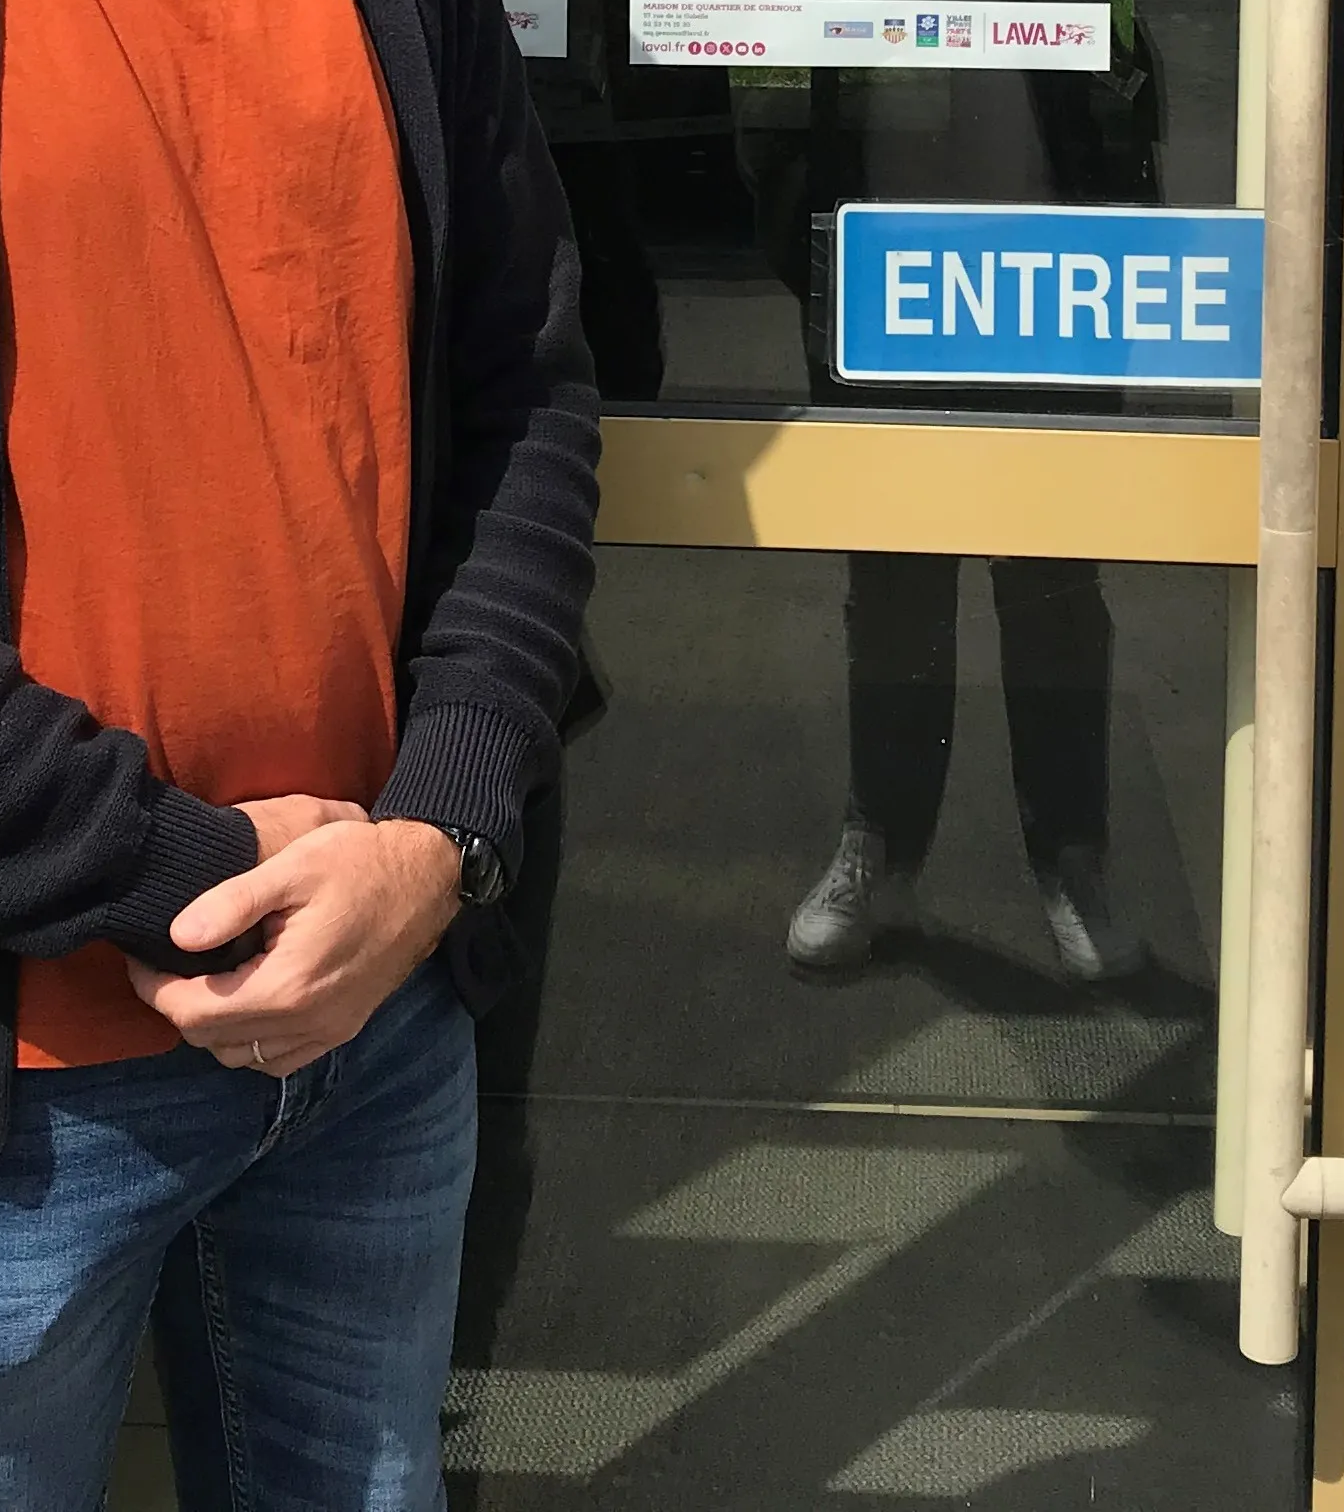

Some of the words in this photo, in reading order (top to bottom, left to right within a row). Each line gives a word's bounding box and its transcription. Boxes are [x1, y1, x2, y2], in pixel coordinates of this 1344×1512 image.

[643, 3, 679, 11] MAISON
[681, 3, 694, 11] DE
[696, 4, 741, 13] QUARTIER
[744, 4, 757, 12] DE
[642, 41, 686, 53] laval.fr
[885, 250, 1230, 341] ENTREE
